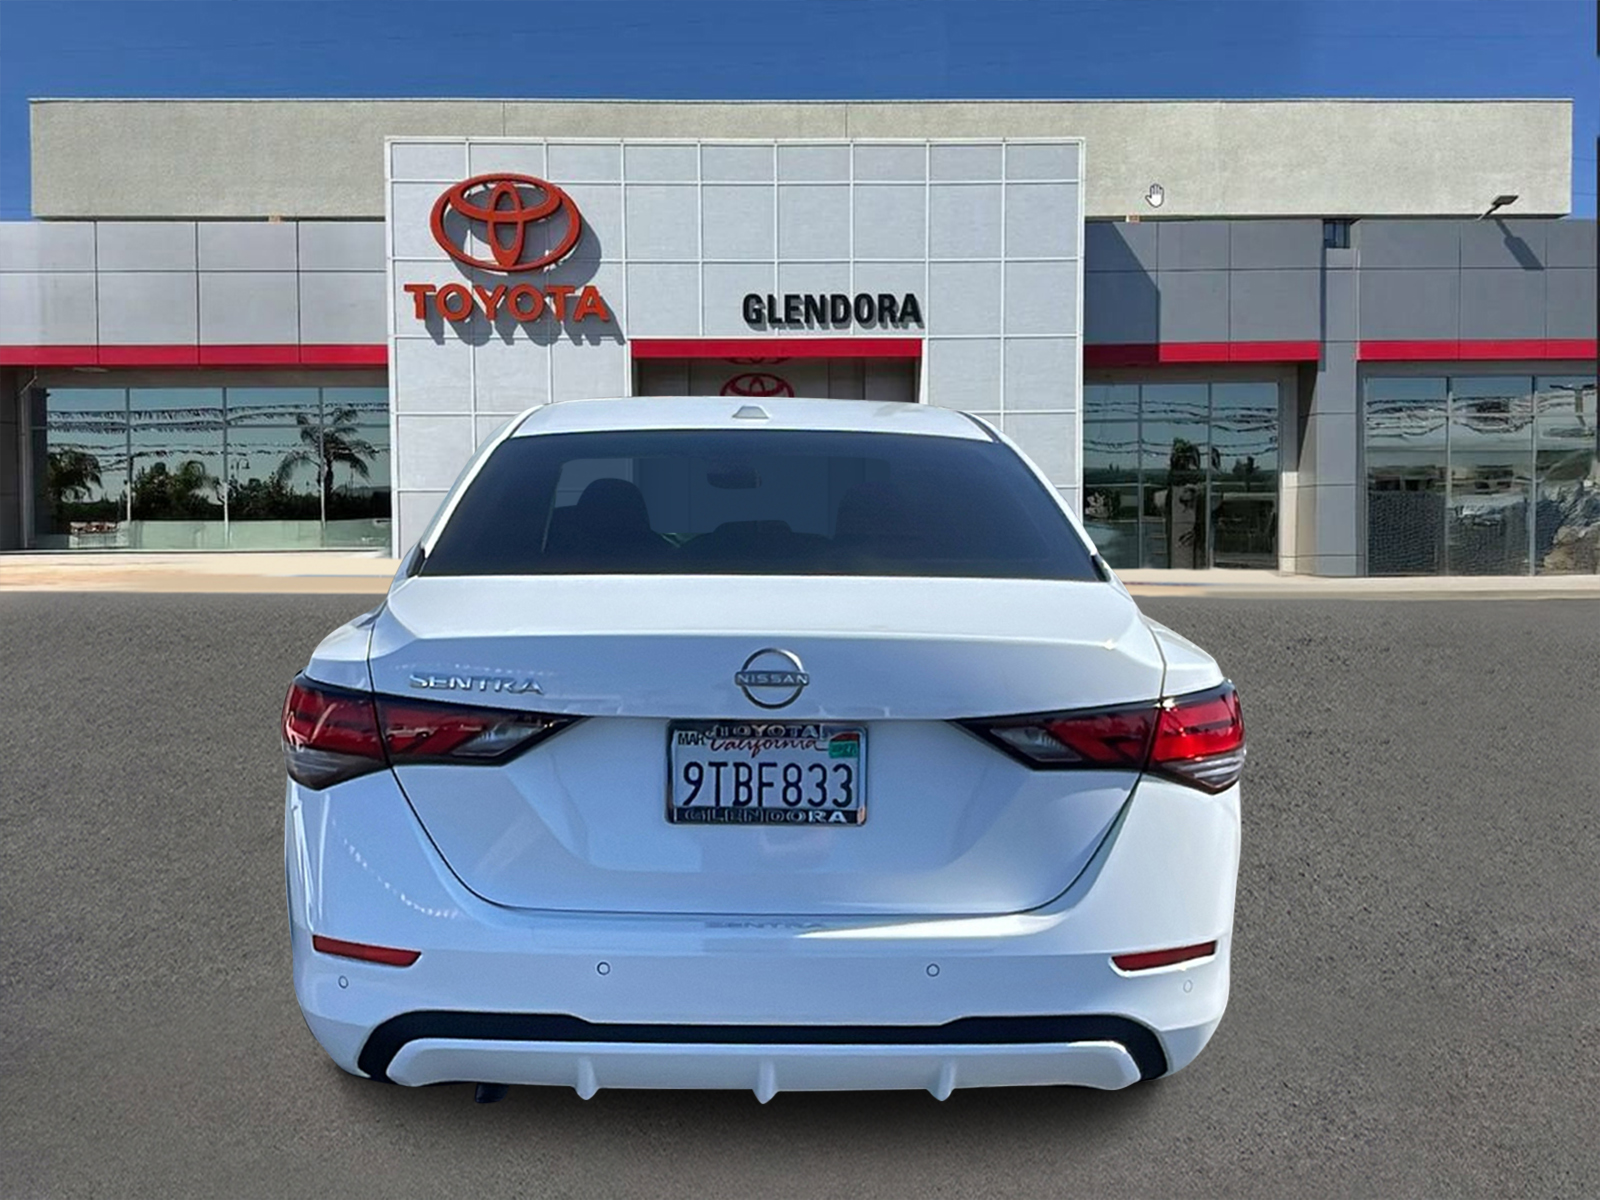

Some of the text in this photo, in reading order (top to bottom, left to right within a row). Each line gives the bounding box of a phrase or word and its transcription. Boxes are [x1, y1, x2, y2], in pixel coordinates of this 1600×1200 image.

[404, 283, 611, 322] TOYOTA
[743, 293, 923, 325] GLENDORA
[410, 673, 544, 695] SENTRA
[737, 673, 808, 685] NISSAN
[710, 738, 828, 758] California
[682, 761, 853, 807] 9TBF833
